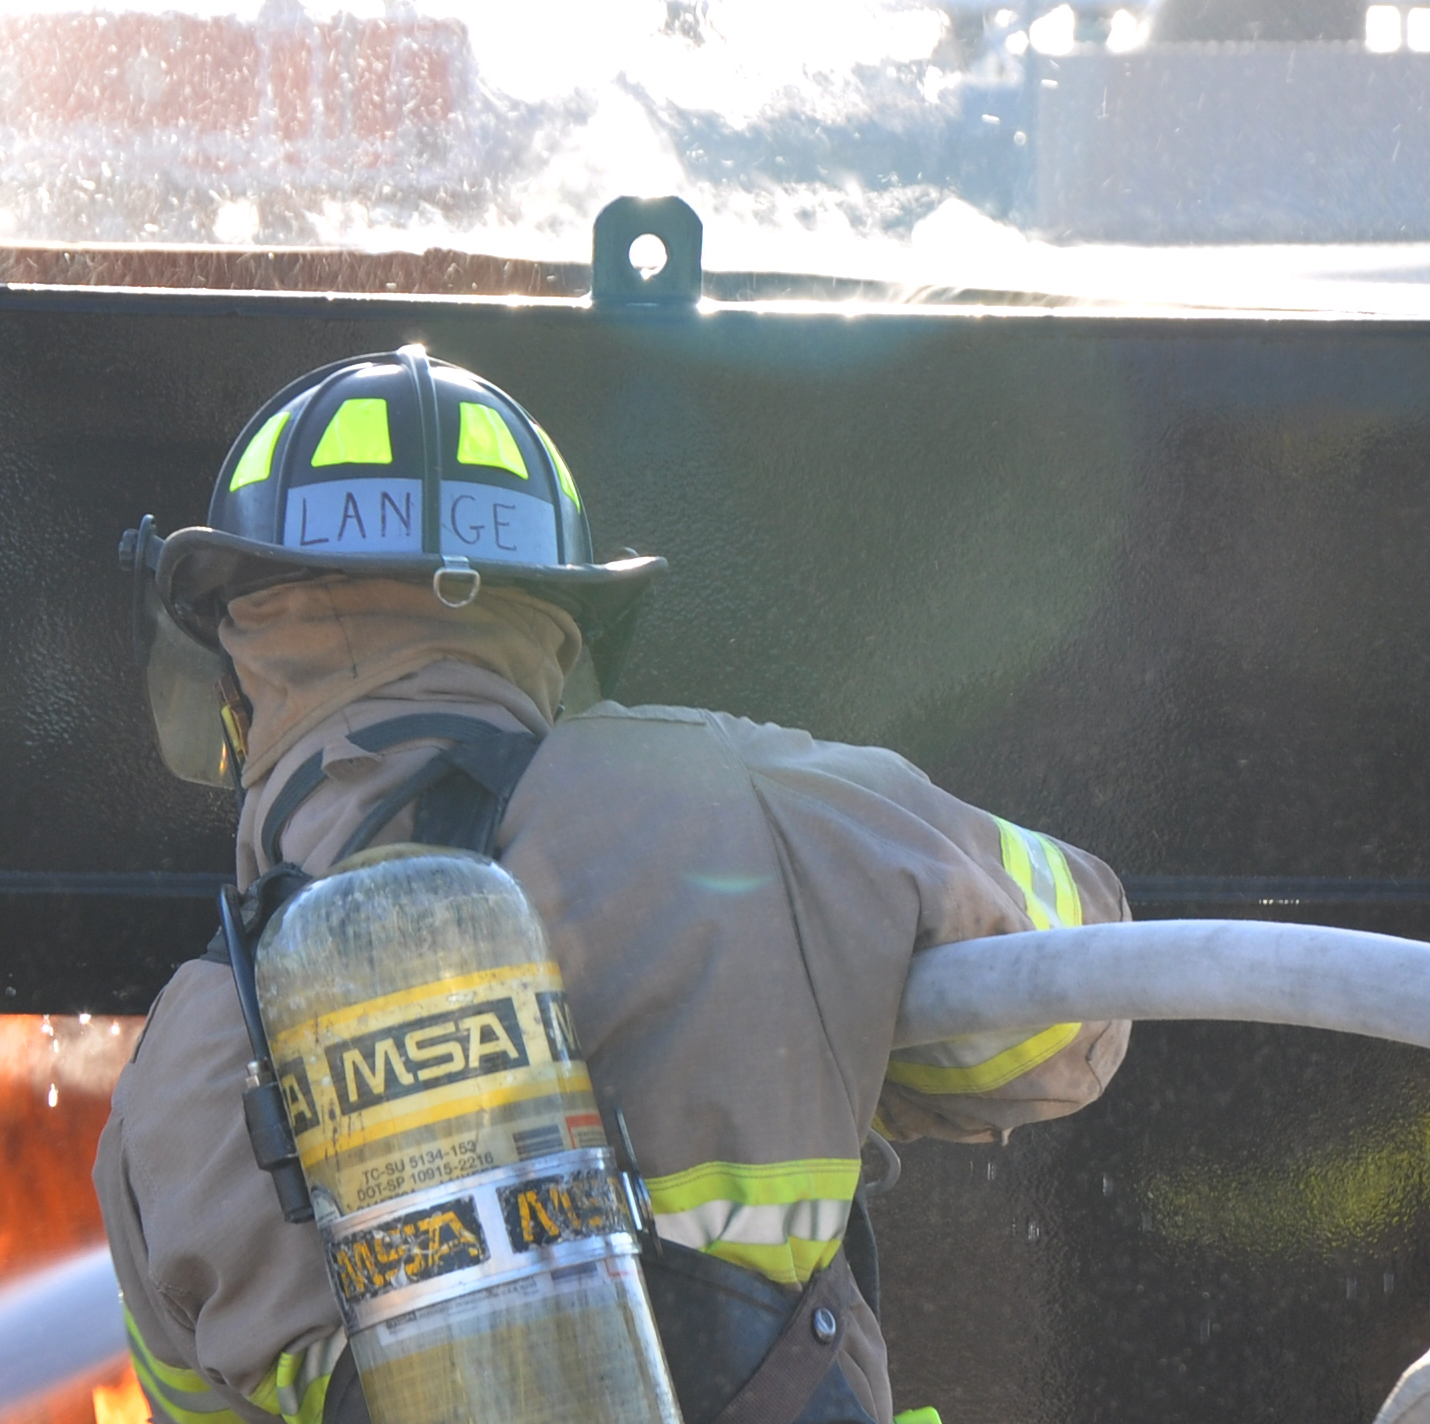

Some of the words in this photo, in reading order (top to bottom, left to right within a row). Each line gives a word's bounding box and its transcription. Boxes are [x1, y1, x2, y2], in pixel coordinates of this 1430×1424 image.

[299, 491, 517, 551] LANGE
[342, 1012, 519, 1103] MSA
[357, 1176, 405, 1201] DOT-SP
[362, 1159, 405, 1185] TC-SU
[336, 1211, 479, 1298] MSA
